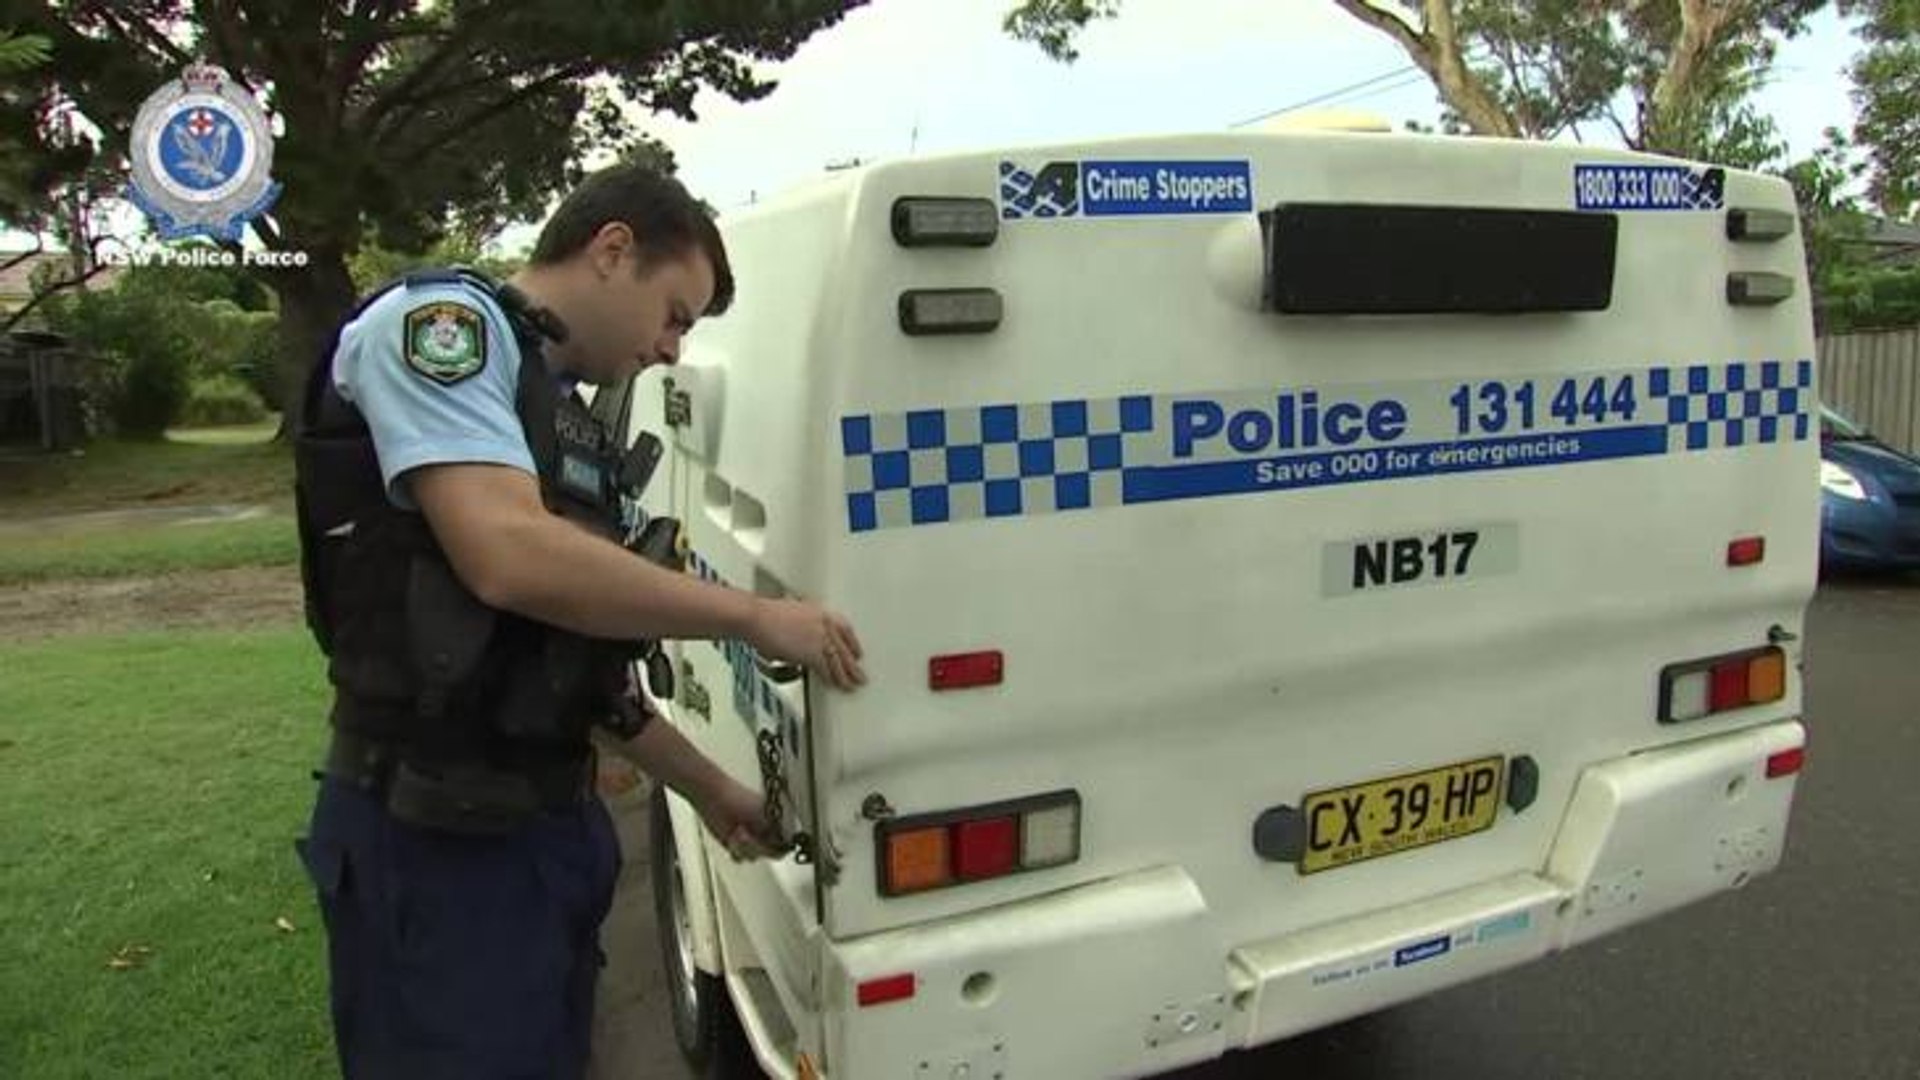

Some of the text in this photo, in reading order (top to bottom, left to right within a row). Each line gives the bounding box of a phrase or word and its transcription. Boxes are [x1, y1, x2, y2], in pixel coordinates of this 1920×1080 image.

[1086, 168, 1248, 208] Crime Stoppers
[1578, 169, 1680, 205] 1800 333 000
[1172, 374, 1637, 458] Police 131 444
[1256, 436, 1581, 484] Save 000 for emergencies
[1352, 531, 1479, 589] NB17
